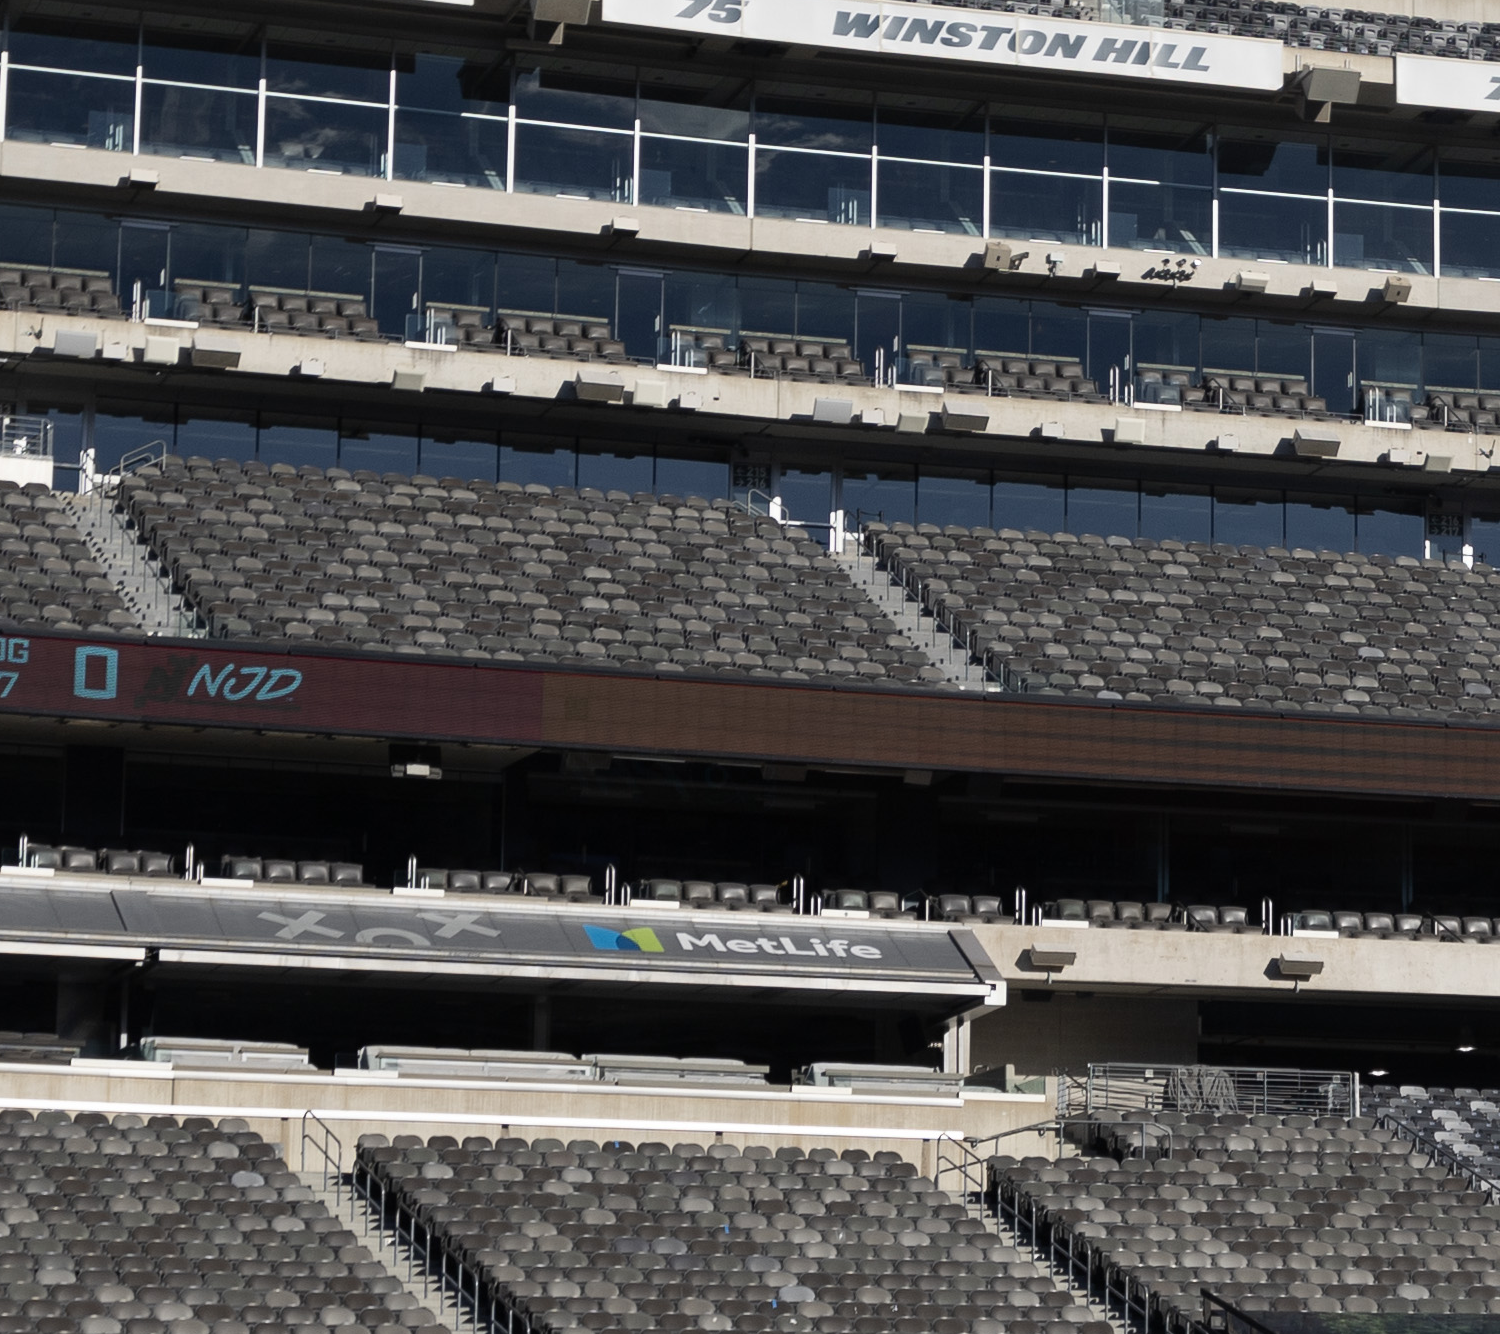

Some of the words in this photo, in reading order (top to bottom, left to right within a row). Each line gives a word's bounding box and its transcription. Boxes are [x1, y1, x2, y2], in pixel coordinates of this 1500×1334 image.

[831, 10, 1088, 61] WINSTON
[1091, 36, 1211, 72] HILL
[747, 466, 767, 477] 215
[747, 478, 766, 488] 216
[1440, 515, 1460, 525] 216
[1440, 526, 1460, 536] 217
[73, 645, 120, 701] 0
[186, 663, 303, 703] NJD
[675, 931, 884, 961] MetLife
